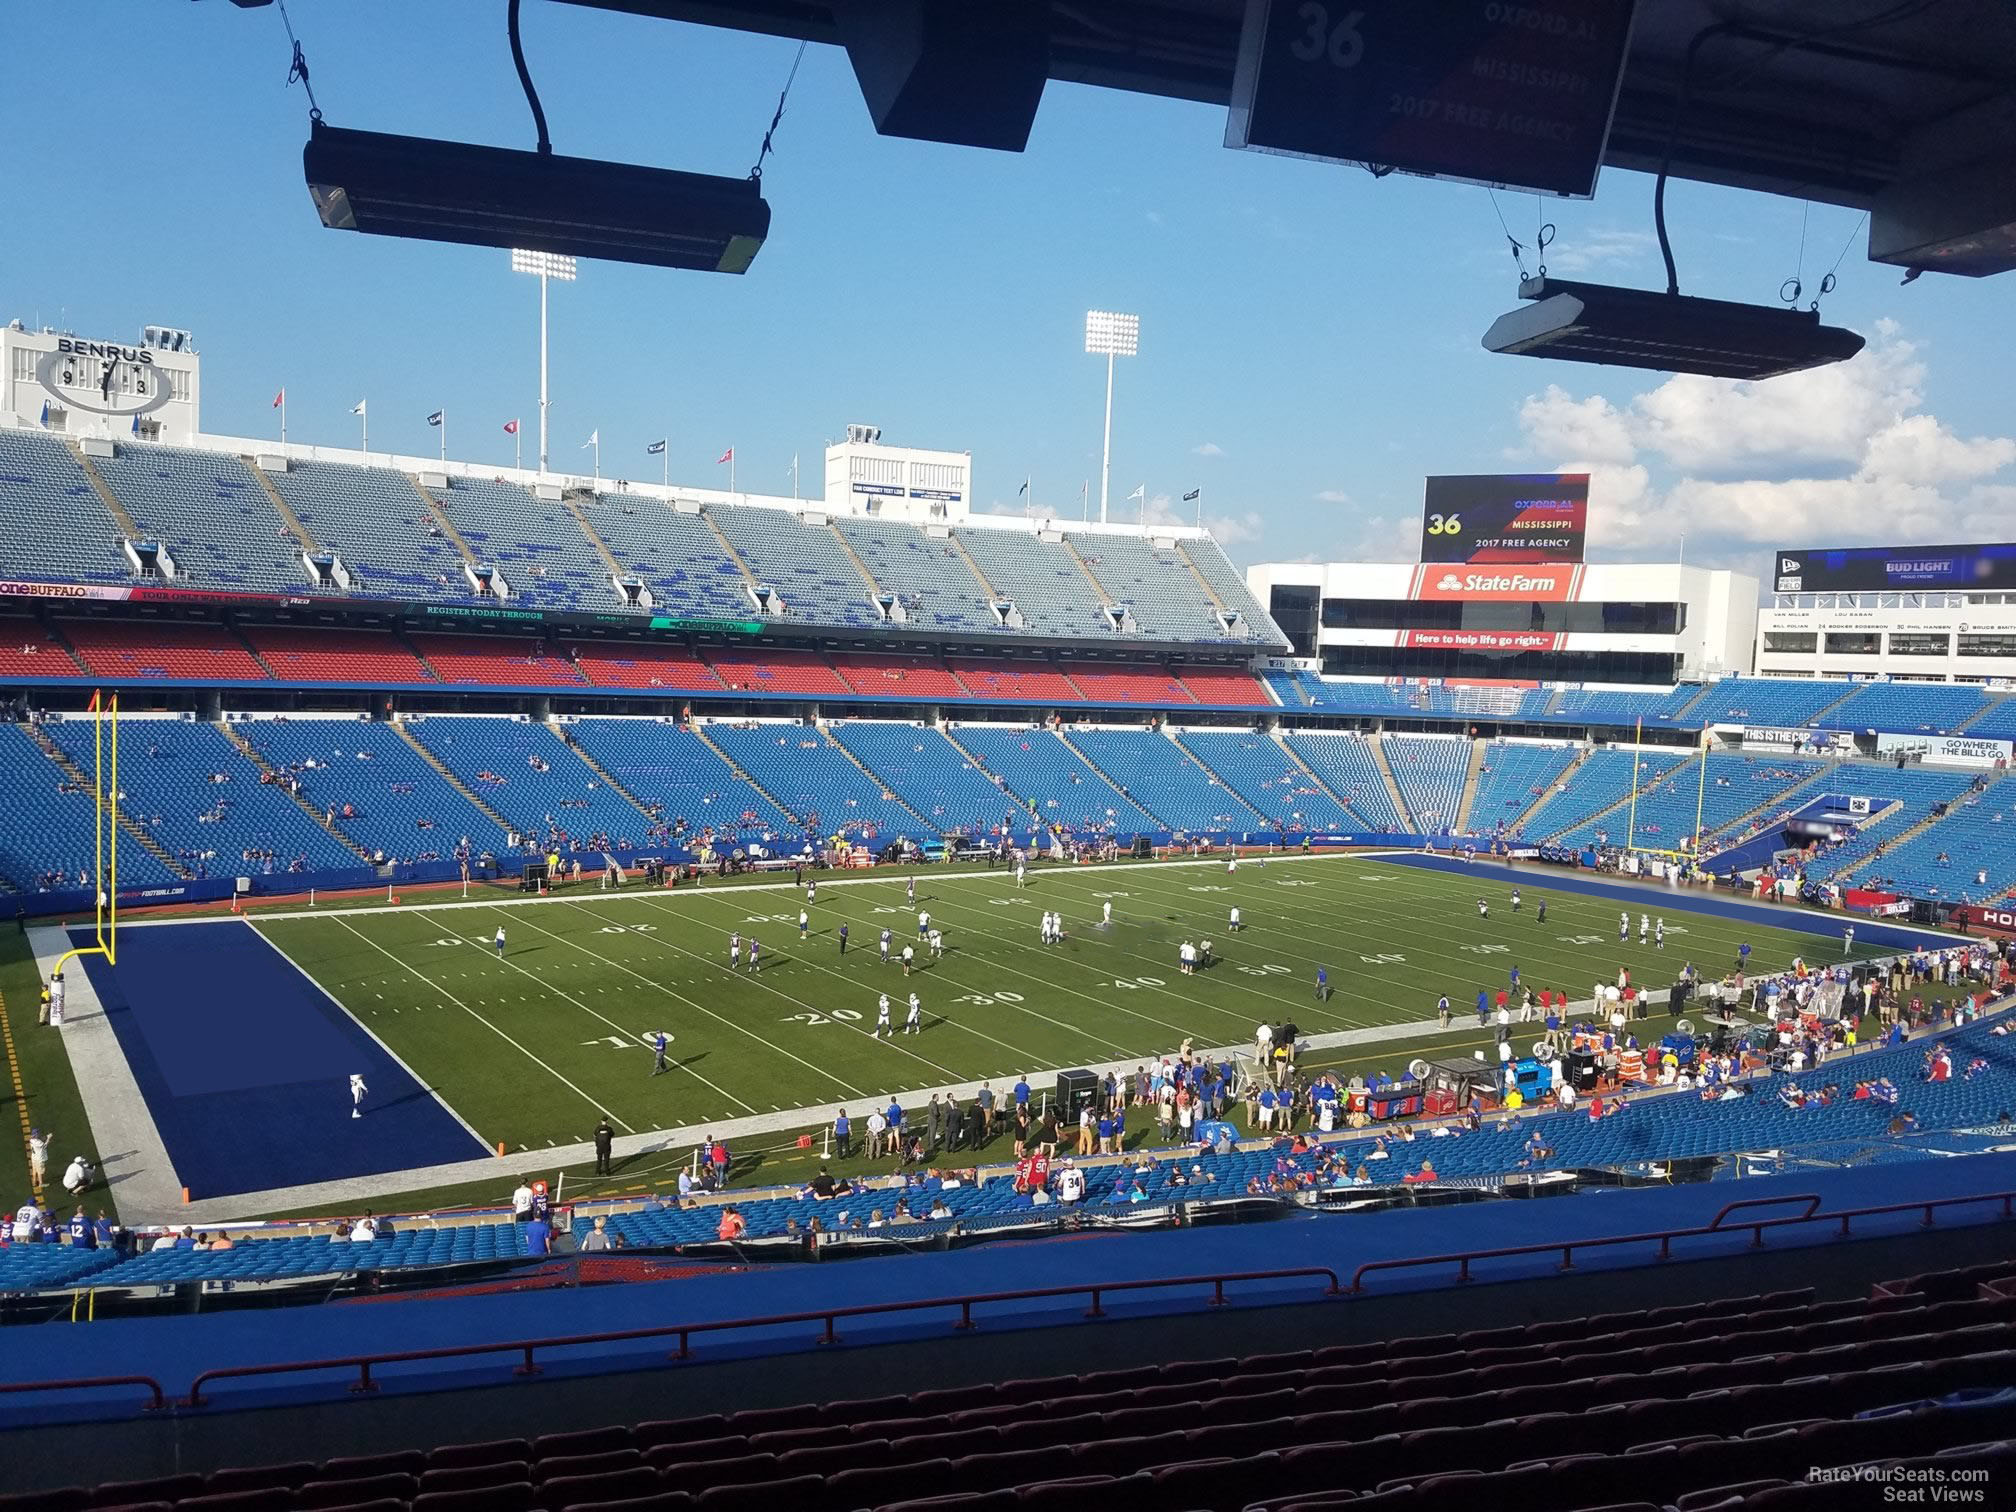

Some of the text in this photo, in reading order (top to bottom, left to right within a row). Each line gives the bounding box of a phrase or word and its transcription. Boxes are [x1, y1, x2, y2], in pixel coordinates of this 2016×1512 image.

[1292, 3, 1364, 67] 36
[1389, 92, 1576, 140] 2017 FREE AGENCY
[58, 338, 153, 364] BENRUS
[1427, 514, 1461, 535] 36
[1512, 520, 1572, 529] MISSISSIPPI
[1475, 539, 1570, 547] 2017 FREE AGENCY
[1886, 562, 1950, 572] BUD LIGHT
[427, 606, 543, 620] REGISTER TODAY THROUGH
[1415, 633, 1544, 647] Here to help life go right.
[1744, 729, 1811, 743] THIS IS THE CAP
[1946, 740, 1999, 750] GO WHERE
[1941, 747, 2006, 759] THE BILLS GO.
[1886, 904, 1910, 914] BILLS
[1983, 910, 2016, 926] HO
[1115, 976, 1166, 990] 40
[962, 991, 1025, 1006] 30
[794, 1009, 864, 1026] 20
[1035, 1162, 1047, 1173] 90
[1068, 1177, 1080, 1188] 34
[71, 1225, 84, 1238] 12
